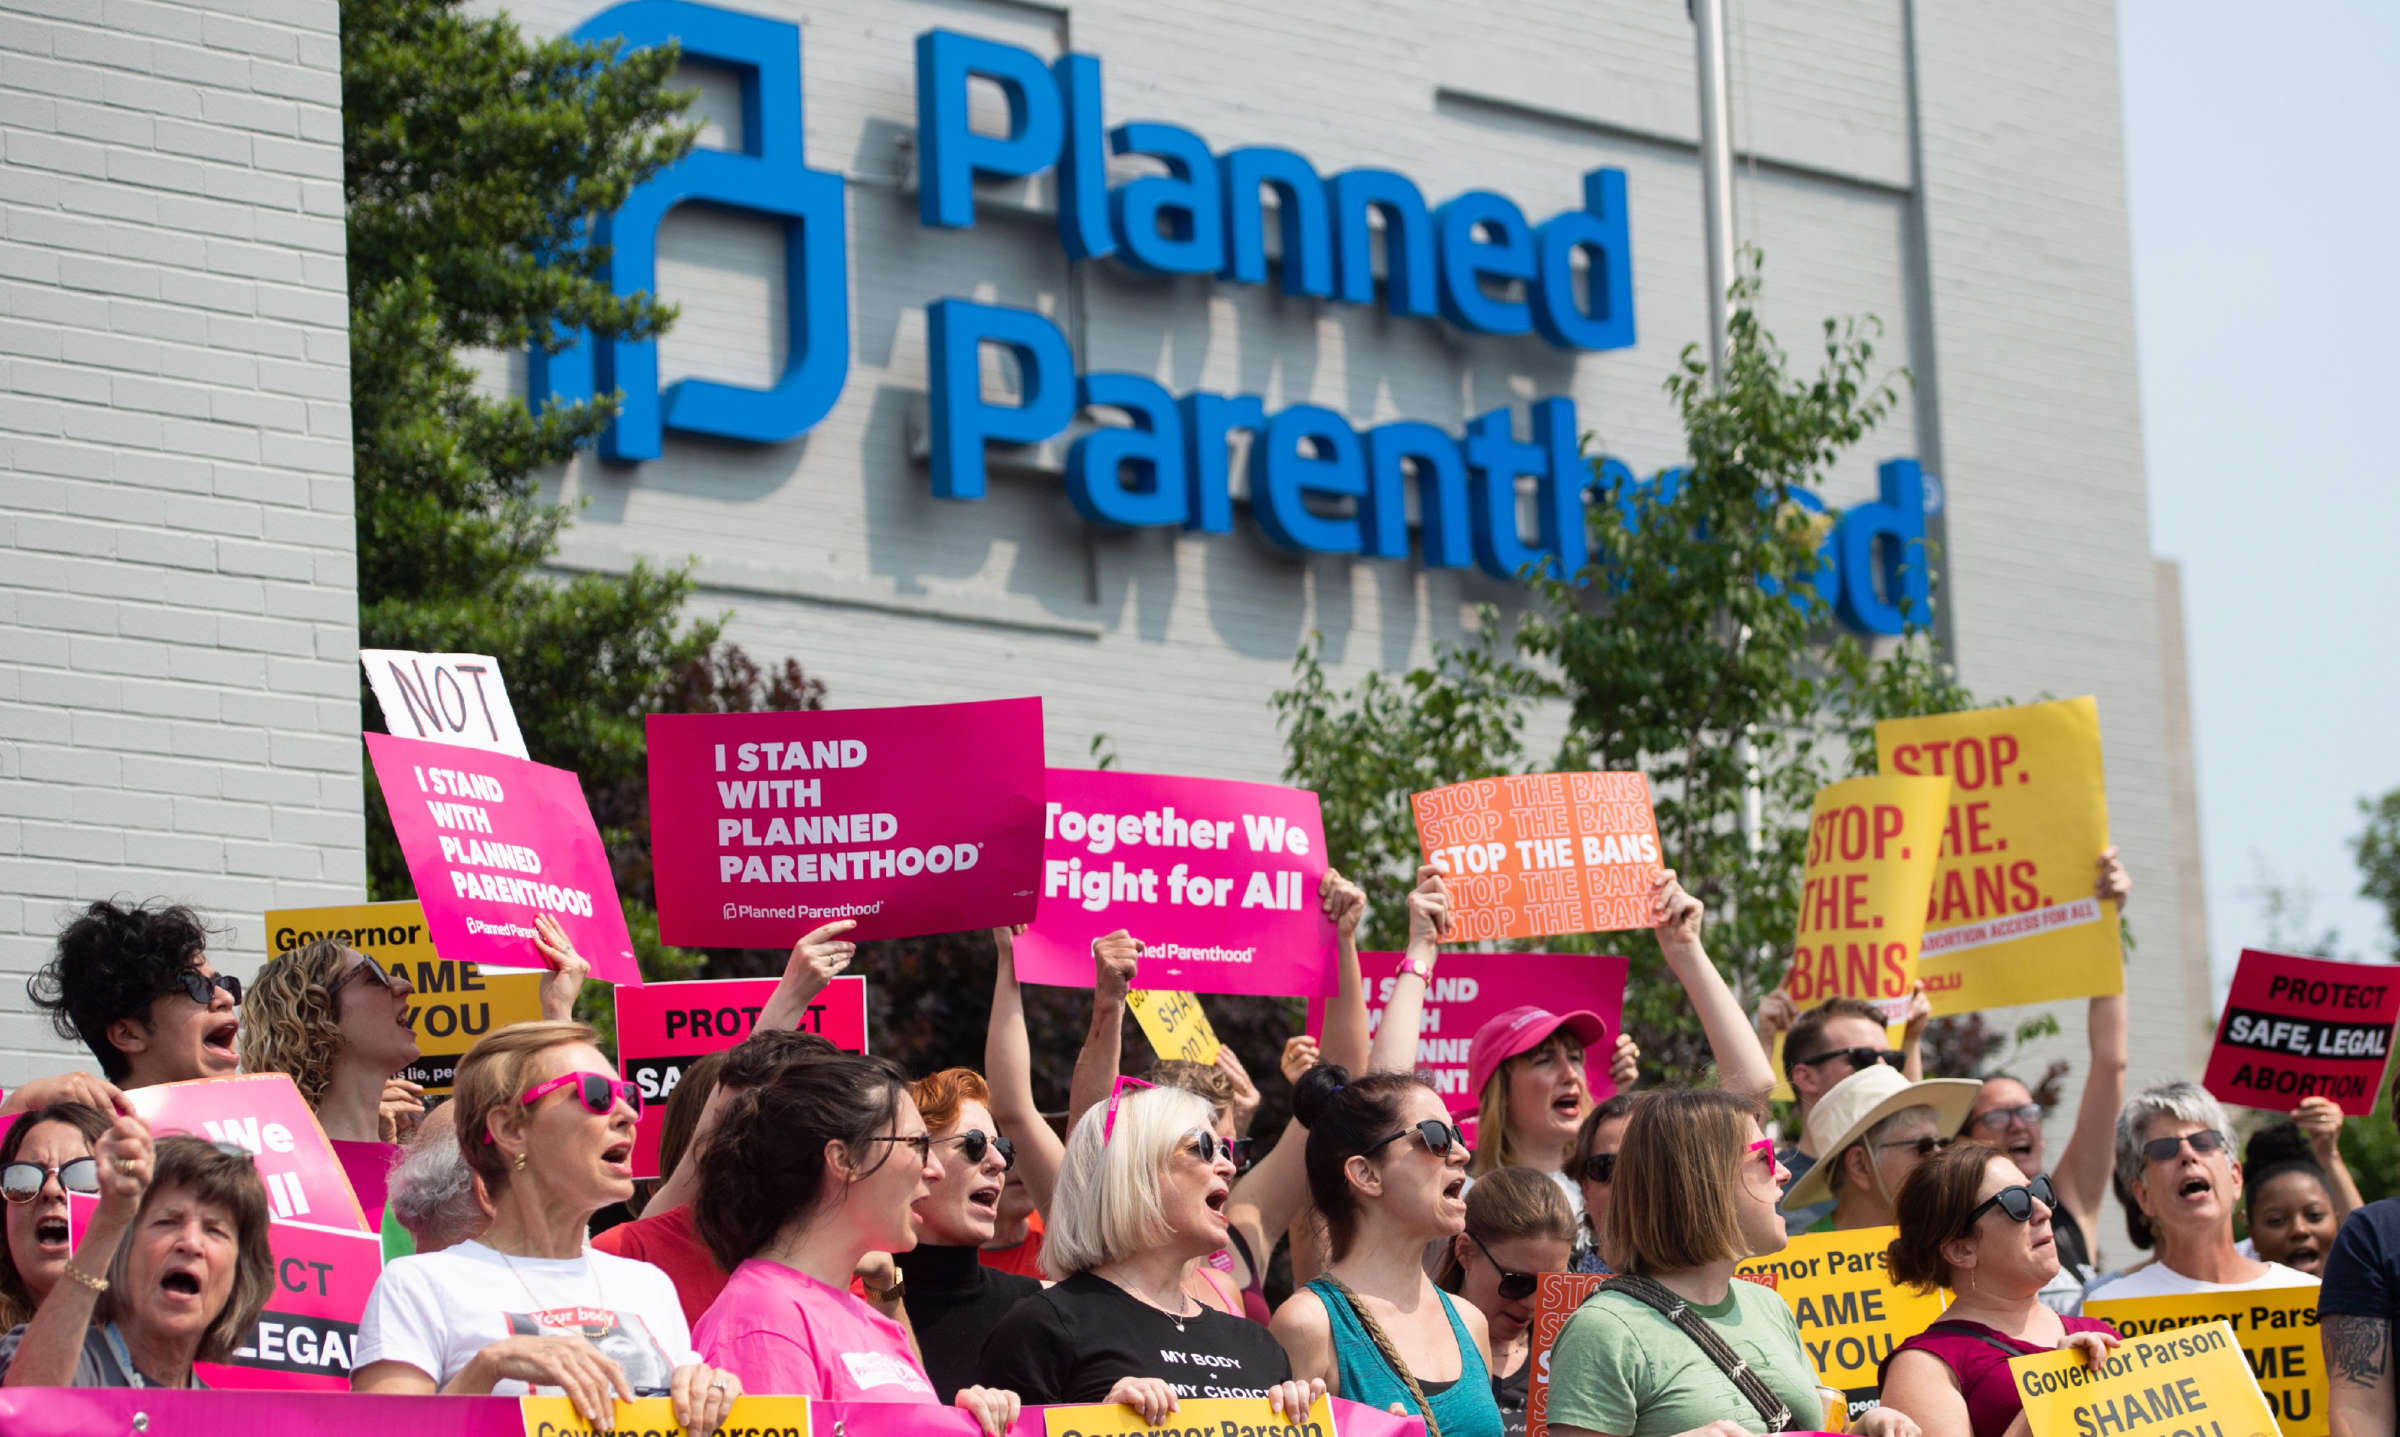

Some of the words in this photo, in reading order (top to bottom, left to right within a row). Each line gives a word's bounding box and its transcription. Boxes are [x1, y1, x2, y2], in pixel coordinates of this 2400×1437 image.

[915, 26, 1637, 352] Planned
[927, 296, 1934, 637] Parenthd
[388, 658, 498, 742] NOT
[713, 744, 726, 772] I
[737, 739, 868, 772] STAND
[1892, 733, 2030, 792] STOP.
[413, 765, 428, 793] I
[430, 769, 505, 803] STAND
[716, 778, 822, 809] WITH
[1416, 780, 1498, 822] STOP
[1504, 774, 1566, 807] THE
[1570, 772, 1646, 804] BANS
[425, 800, 493, 834] WITH
[718, 812, 898, 847] PLANNED
[1045, 802, 1235, 855] Together
[1242, 814, 1310, 855] We
[1423, 810, 1503, 850] STOP
[1509, 806, 1571, 839] THE
[1575, 803, 1652, 836] BANS
[1808, 804, 1912, 869] STOP.
[1936, 801, 2008, 858] HE.
[438, 835, 542, 875] PLANNED
[719, 842, 980, 883] PARENTHOOD
[1429, 842, 1508, 876] STOP
[1514, 838, 1576, 870] THE
[1580, 834, 1659, 867] BANS
[450, 870, 594, 918] PARENTHOOD
[1045, 857, 1158, 912] Fight
[1166, 863, 1234, 907] for
[1240, 870, 1302, 911] All
[1519, 869, 1580, 904] THE
[1800, 873, 1884, 933] THE.
[474, 919, 511, 937] Planned
[738, 904, 796, 919] Planned
[798, 901, 880, 918] Parenthood
[1523, 901, 1586, 936] THE
[1990, 917, 2040, 938] ACCESS
[2043, 908, 2067, 925] FOR
[2070, 903, 2094, 919] ALL
[1167, 943, 1254, 963] Parenthood
[389, 960, 486, 994] AME
[2268, 975, 2388, 1010] PROTECT
[2229, 1015, 2312, 1056] SAFE,
[2317, 1027, 2387, 1057] LEGAL
[2231, 1064, 2368, 1098] ABORTION
[203, 1116, 295, 1156] We
[1826, 1249, 1889, 1275] Pars
[532, 1309, 574, 1326] Your
[1795, 1288, 1887, 1330] AME
[2250, 1305, 2320, 1331] Pars
[1160, 1349, 1187, 1365] MY
[1190, 1352, 1242, 1369] BODY
[1805, 1332, 1894, 1374] YOU
[2022, 1348, 2134, 1397] Governor
[2135, 1329, 2228, 1369] Parson
[2073, 1376, 2208, 1437] SHAME
